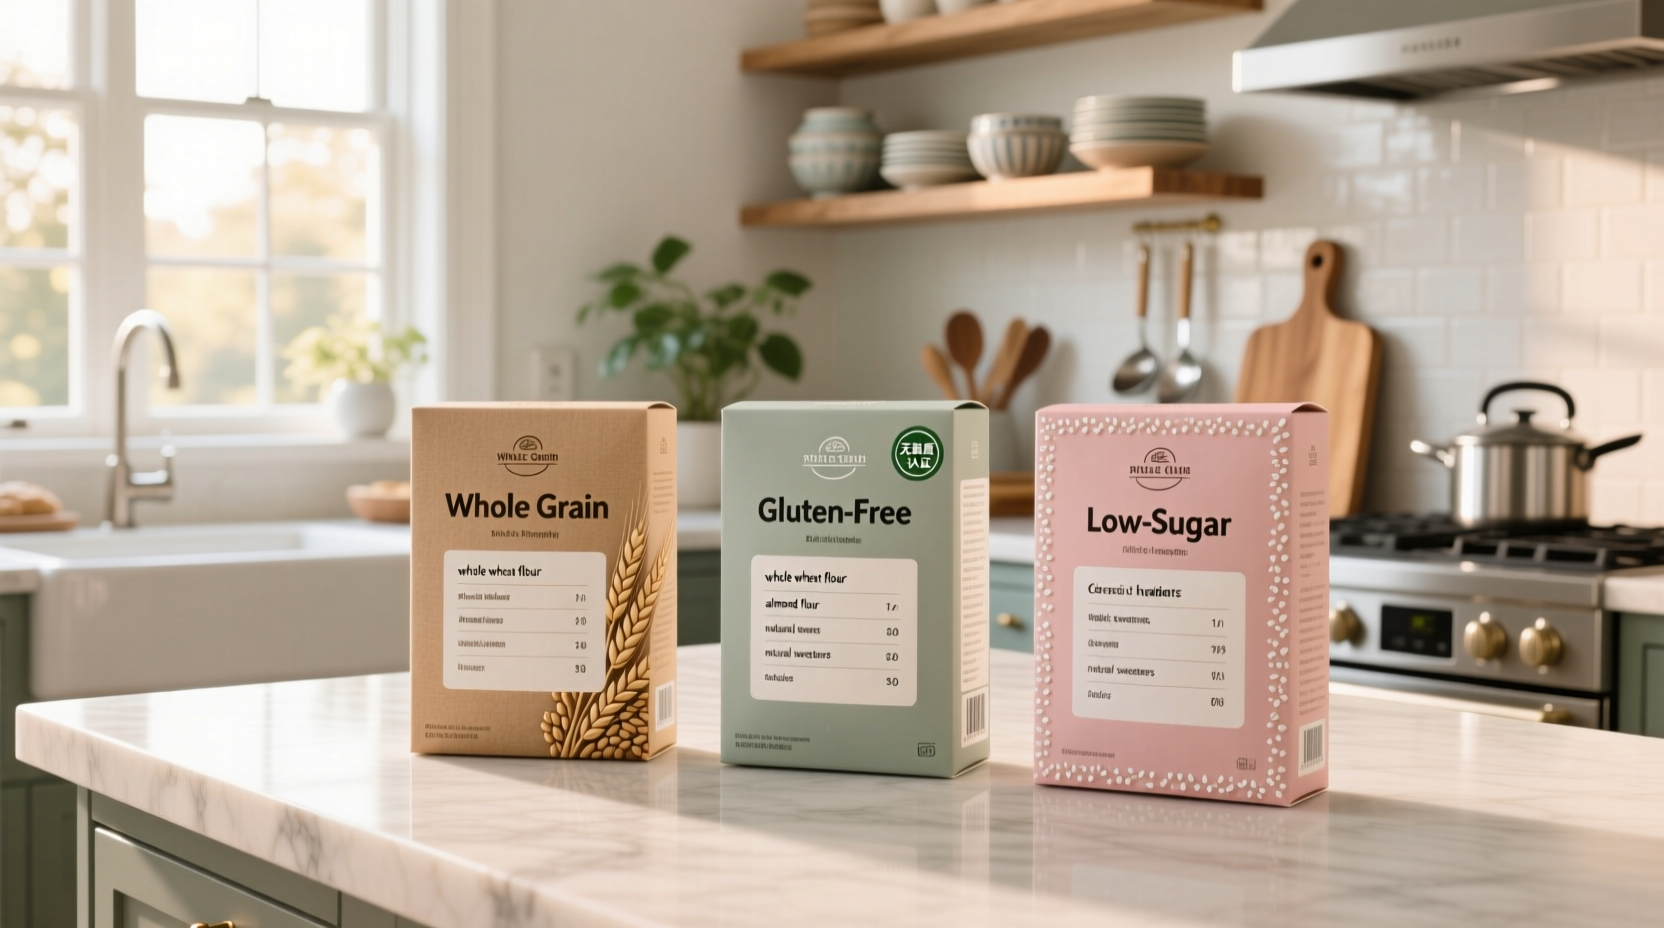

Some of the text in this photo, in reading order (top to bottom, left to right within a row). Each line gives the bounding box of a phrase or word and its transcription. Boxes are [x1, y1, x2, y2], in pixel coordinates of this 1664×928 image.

[445, 492, 609, 519] Whole Grain
[757, 496, 912, 525] Gluten-Free
[1087, 506, 1232, 543] Low-Sugar
[824, 571, 847, 584] flour
